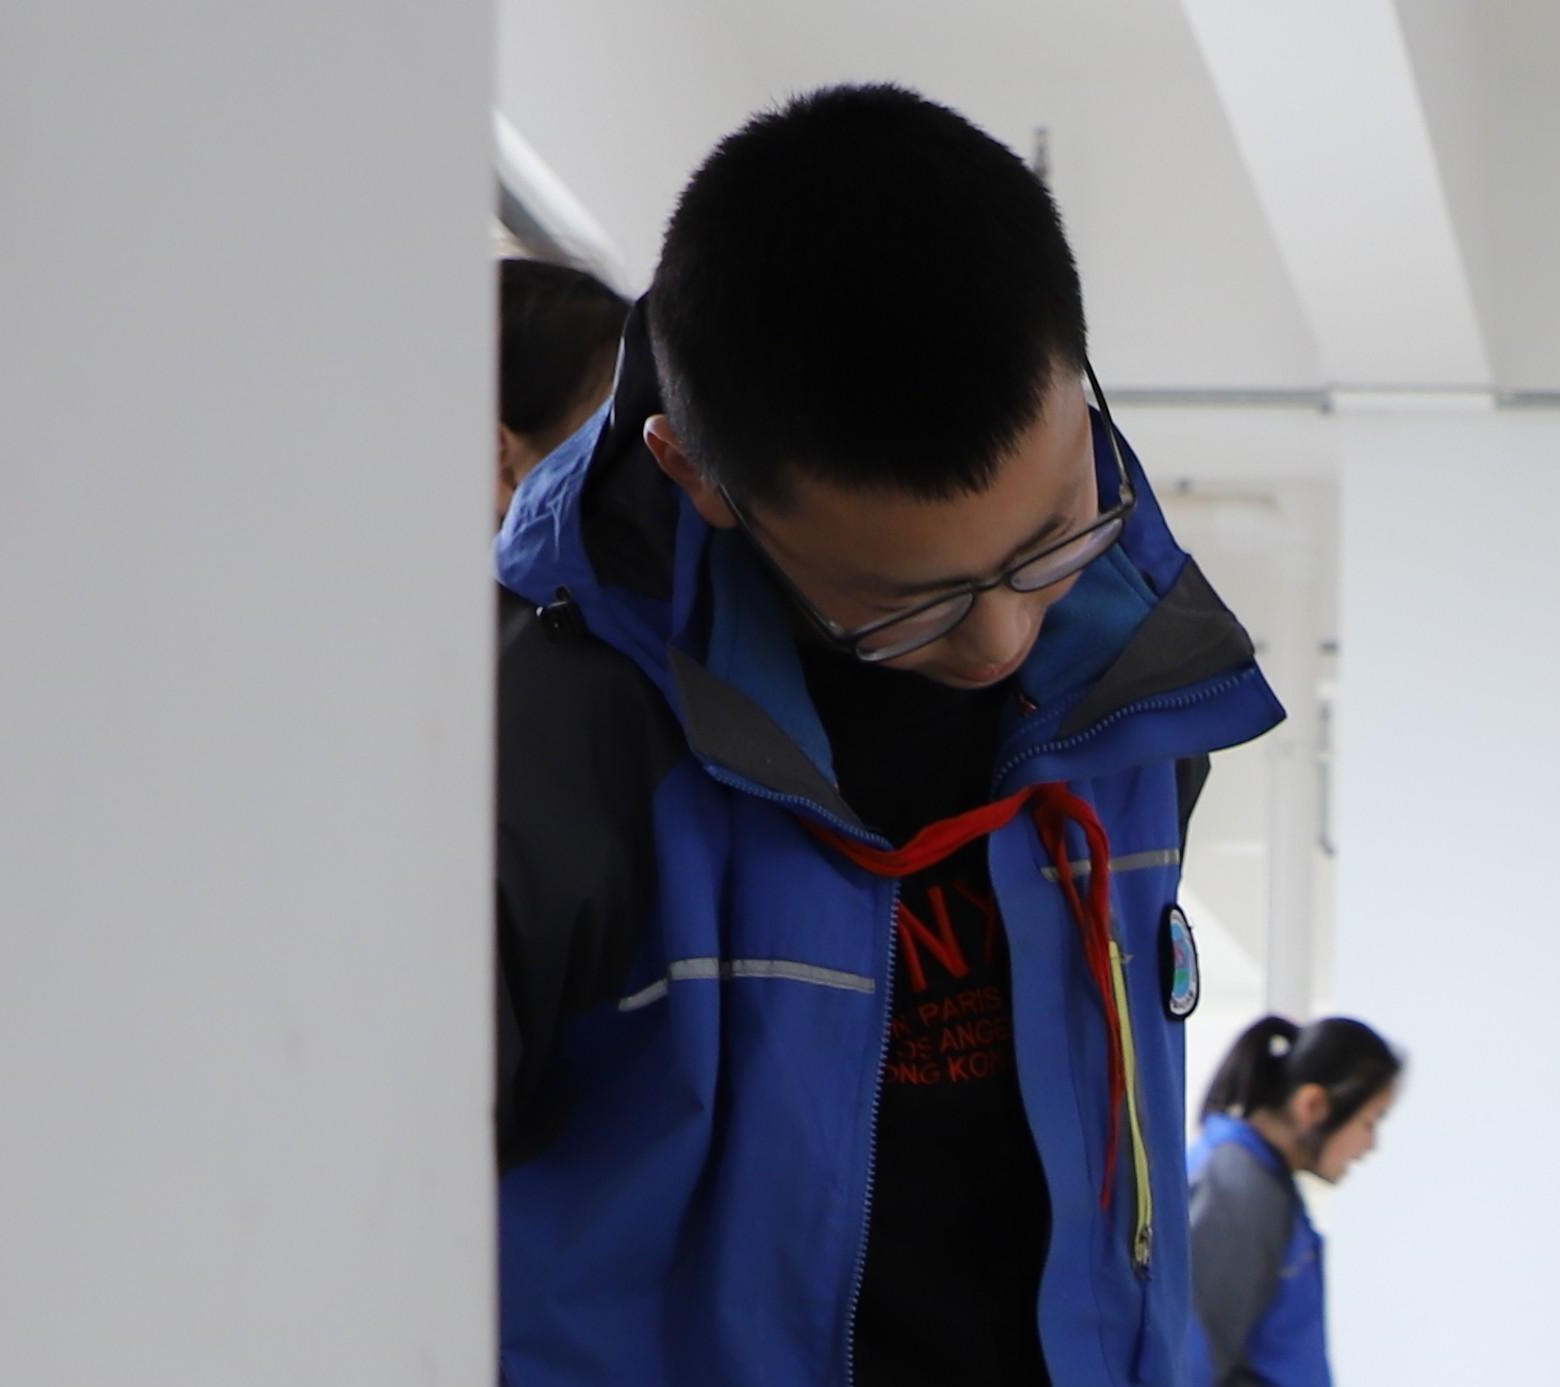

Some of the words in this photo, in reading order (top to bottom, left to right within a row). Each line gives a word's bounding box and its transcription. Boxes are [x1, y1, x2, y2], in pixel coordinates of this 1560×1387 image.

[919, 985, 1002, 1026] PARIS
[940, 1016, 1011, 1054] ANGE
[884, 1062, 941, 1087] ONG
[947, 1050, 1005, 1085] KON
